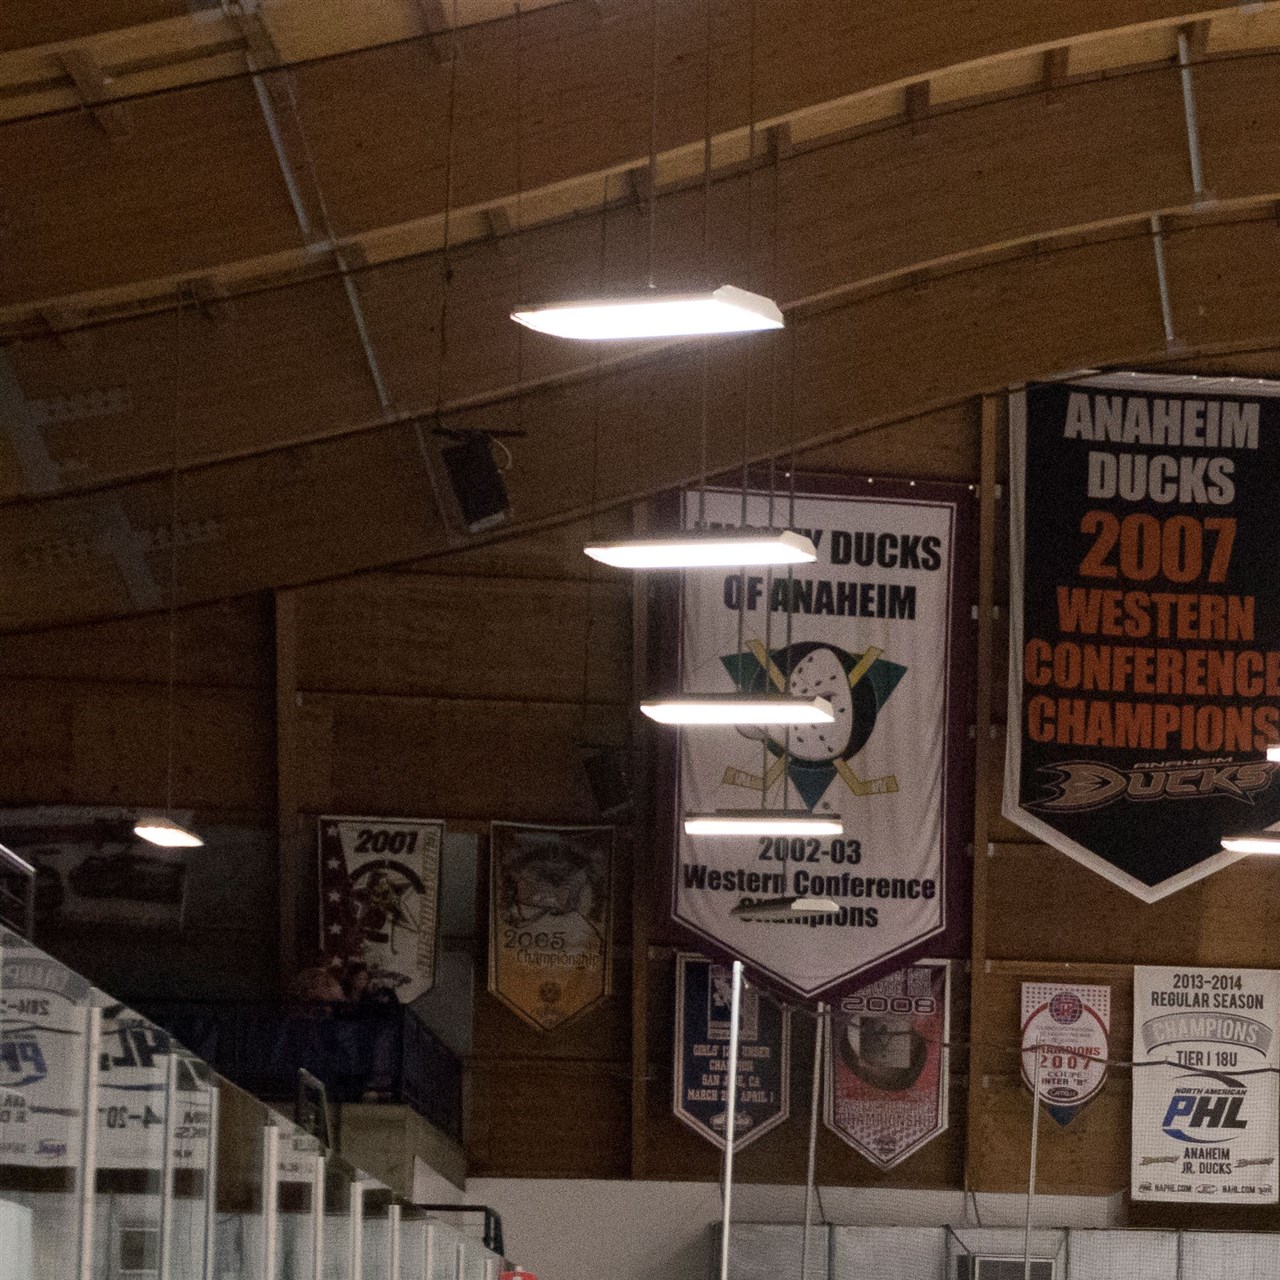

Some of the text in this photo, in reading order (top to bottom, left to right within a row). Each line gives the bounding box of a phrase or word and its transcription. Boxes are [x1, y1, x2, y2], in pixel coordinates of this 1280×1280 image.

[1064, 392, 1260, 449] ANAHEIM
[1087, 451, 1236, 505] DUCKS
[830, 530, 941, 571] DUCKS
[1079, 510, 1237, 583] 2007
[723, 575, 917, 620] OF ANAHEIM
[1056, 586, 1255, 642] WESTERN
[1027, 696, 1280, 752] CHAMPIONS
[1133, 756, 1234, 769] ANAHEIM
[1020, 759, 1280, 813] DUCKS
[354, 829, 418, 854] 2001
[758, 837, 861, 865] 2002-03
[683, 863, 936, 900] Western Conference
[1173, 974, 1242, 991] 2013-2014
[842, 996, 936, 1015] 2008
[1151, 991, 1265, 1009] REGULAR SEASON
[1151, 1014, 1259, 1044] CHAMPIONS
[1176, 1050, 1204, 1066] TIER
[1215, 1052, 1238, 1067] 18U
[1174, 1087, 1248, 1096] NORTH AMERICAN
[1162, 1095, 1248, 1129] PHL
[1181, 1162, 1232, 1175] JR. DUCKS
[1183, 1147, 1230, 1160] ANAHEIM
